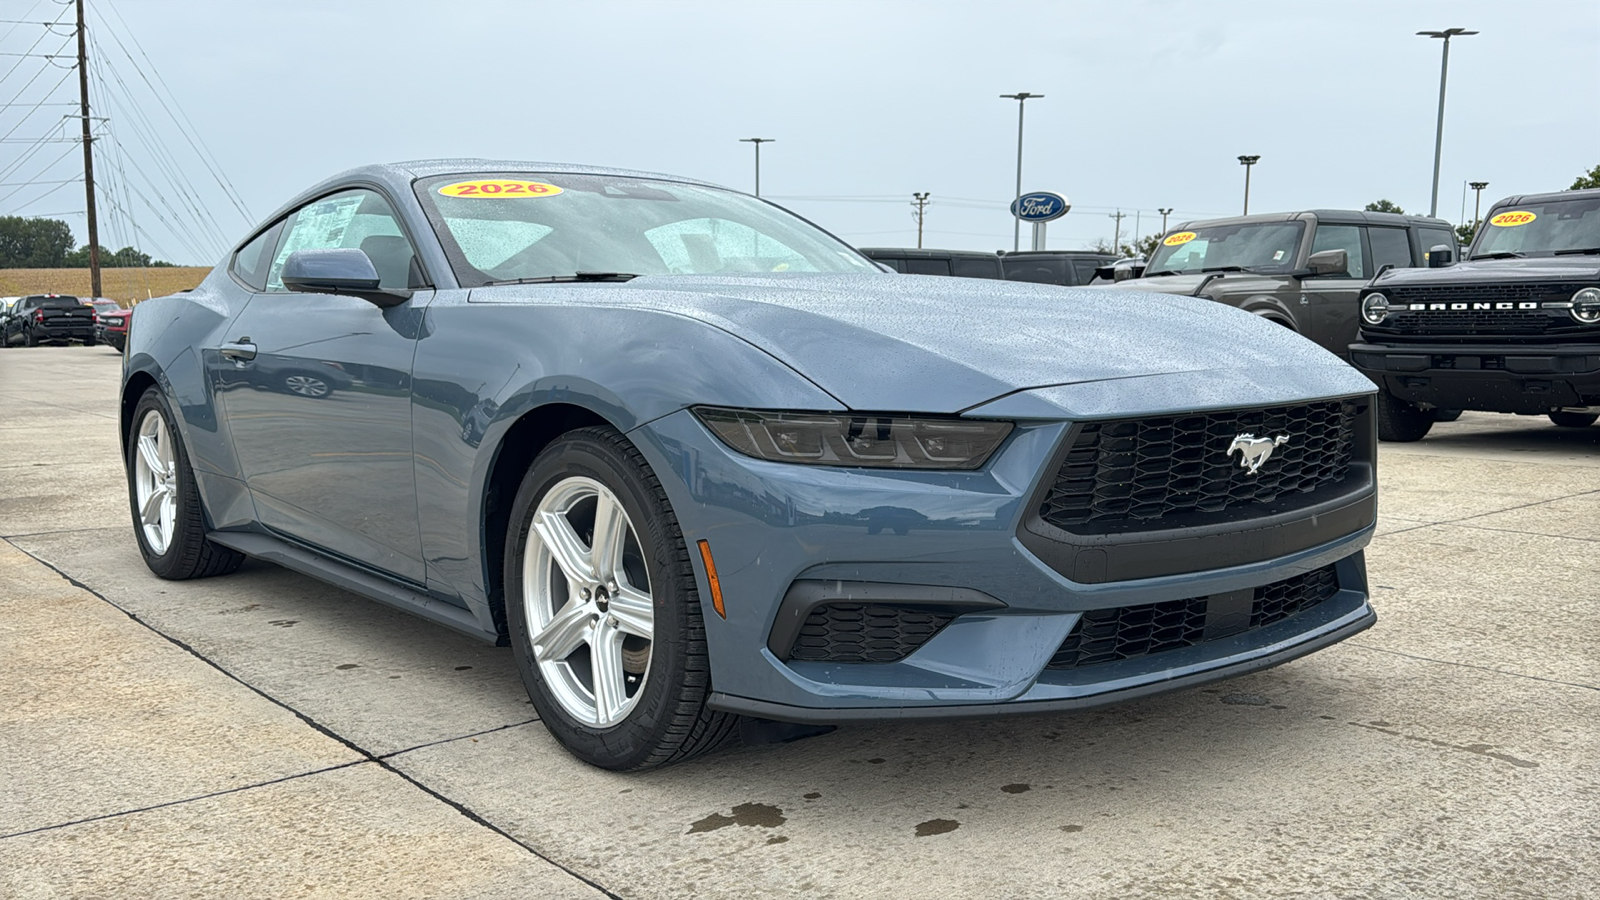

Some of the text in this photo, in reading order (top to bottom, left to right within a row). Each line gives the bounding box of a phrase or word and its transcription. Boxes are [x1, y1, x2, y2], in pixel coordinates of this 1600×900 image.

[457, 184, 549, 196] 2026
[1020, 197, 1054, 216] Ford
[1494, 214, 1532, 224] 2026
[1166, 234, 1193, 244] 2026
[1409, 302, 1537, 311] BRONCO
